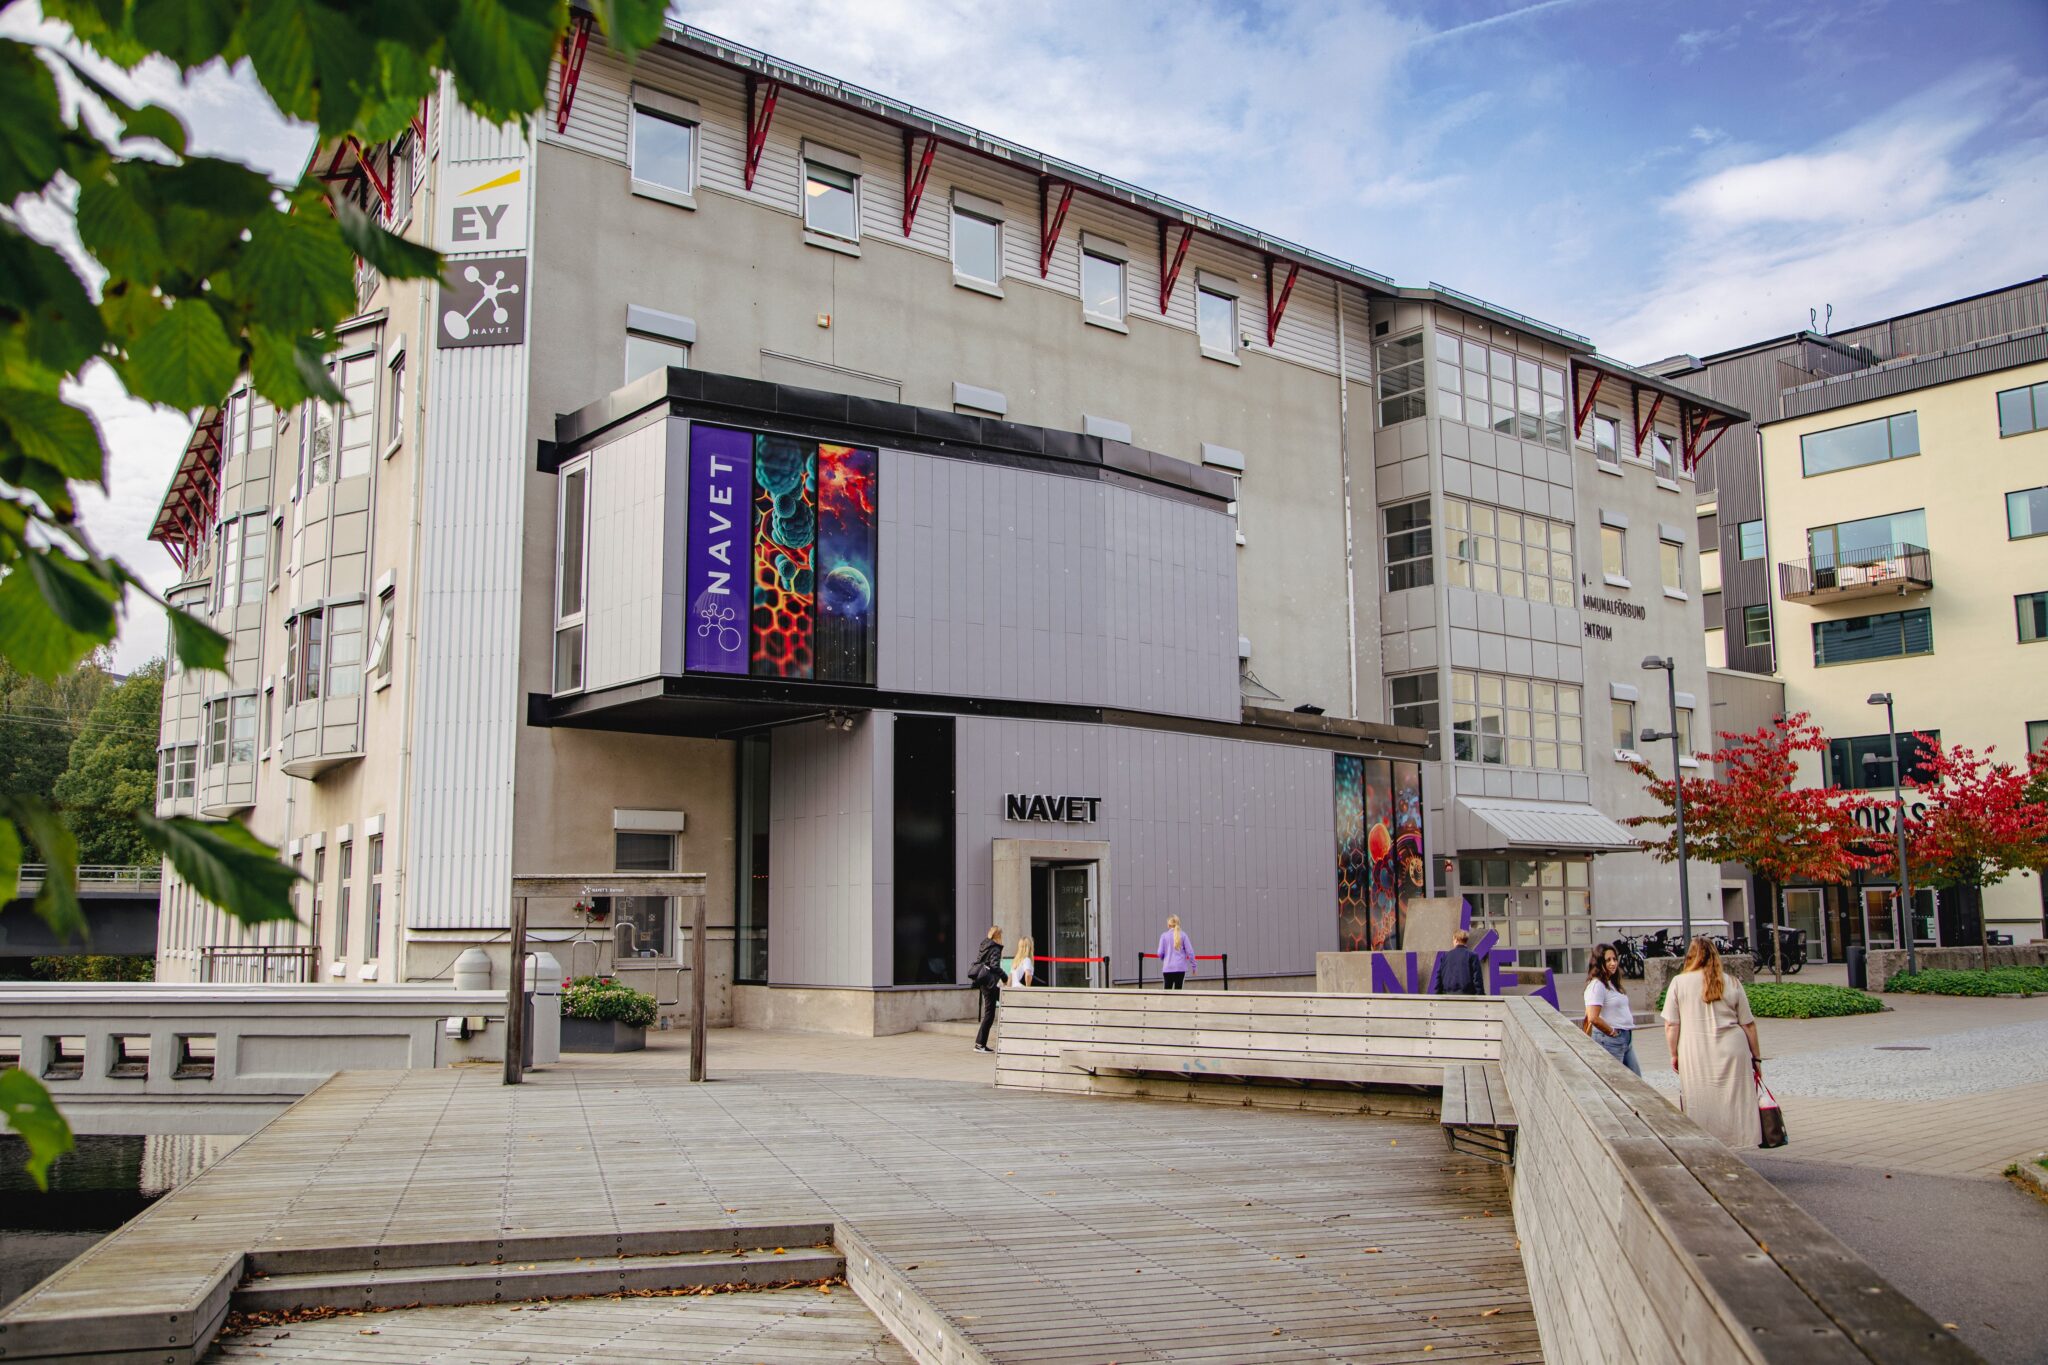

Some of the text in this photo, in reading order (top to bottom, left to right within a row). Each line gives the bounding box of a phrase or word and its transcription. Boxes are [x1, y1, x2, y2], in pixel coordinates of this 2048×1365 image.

[452, 204, 509, 242] EY
[473, 327, 510, 335] NAVET
[708, 455, 733, 596] NAVET
[1004, 793, 1102, 824] NAVET
